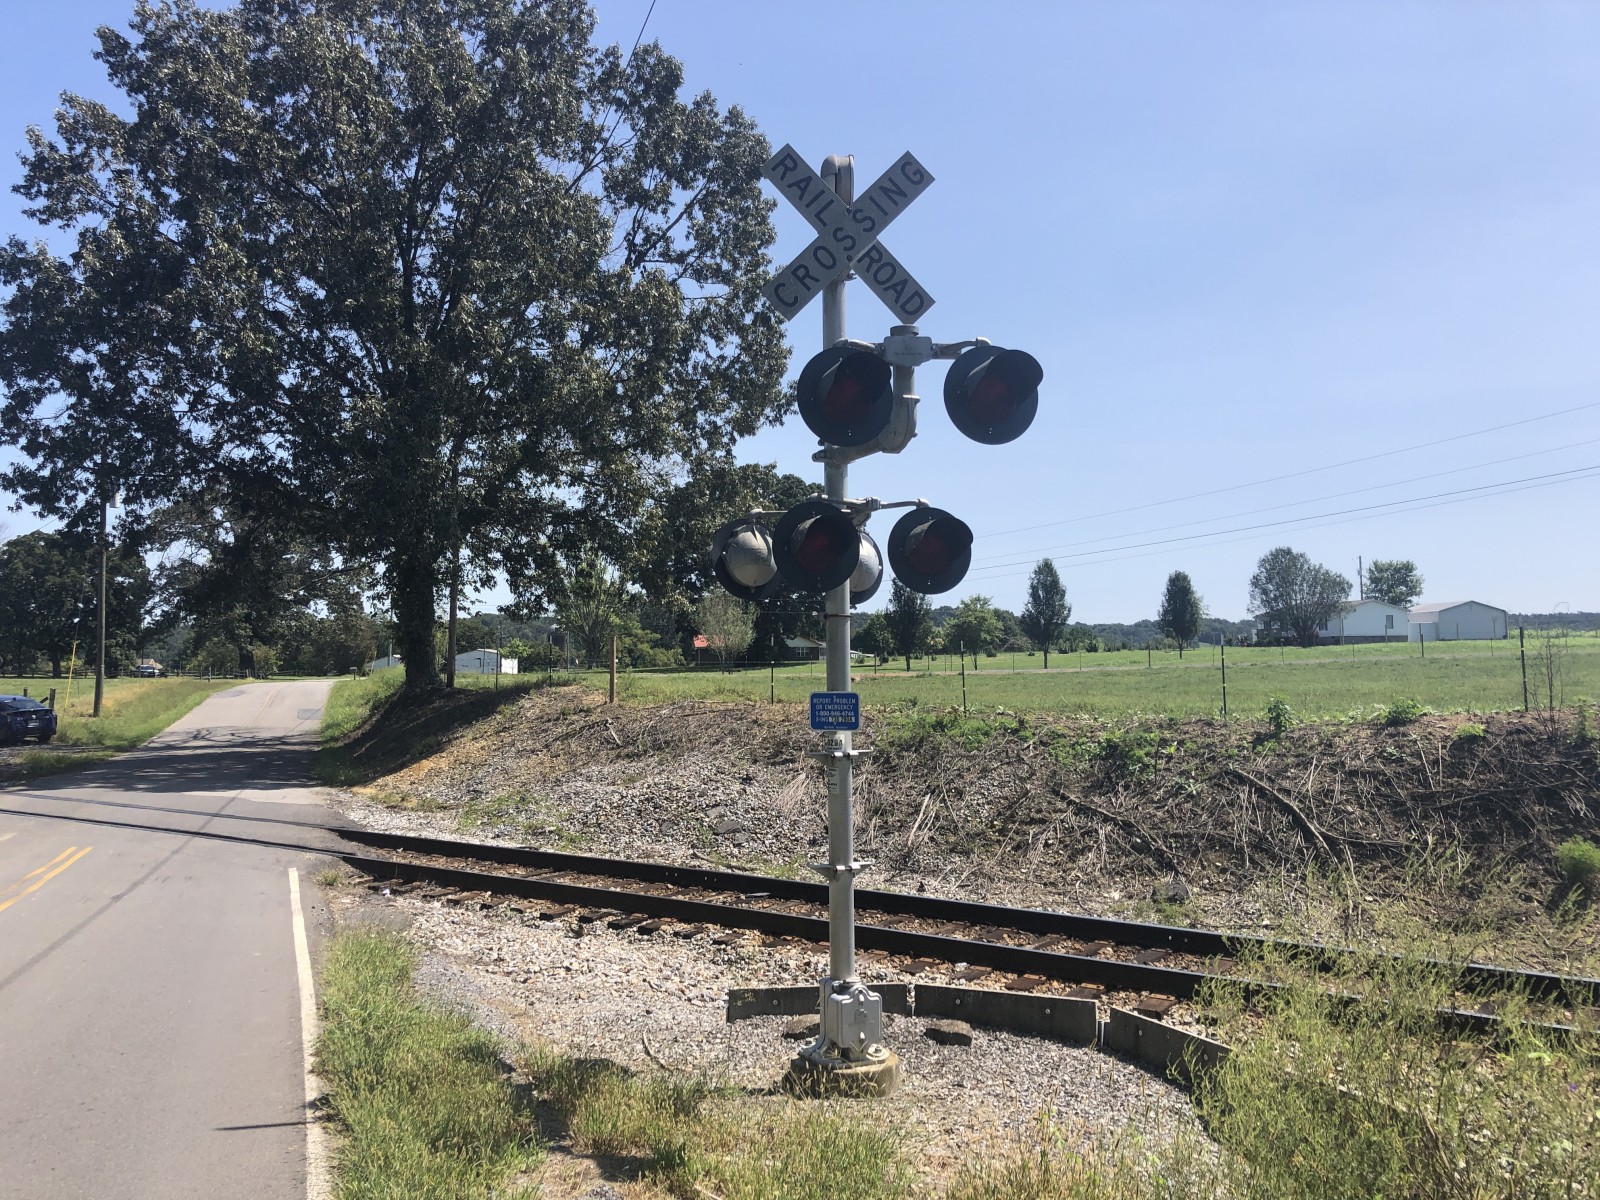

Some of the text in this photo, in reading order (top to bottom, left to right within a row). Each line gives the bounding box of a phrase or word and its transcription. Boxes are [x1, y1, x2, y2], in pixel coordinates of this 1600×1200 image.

[770, 152, 835, 227] RAIL
[773, 161, 925, 308] CROSSING
[856, 245, 925, 316] ROAD
